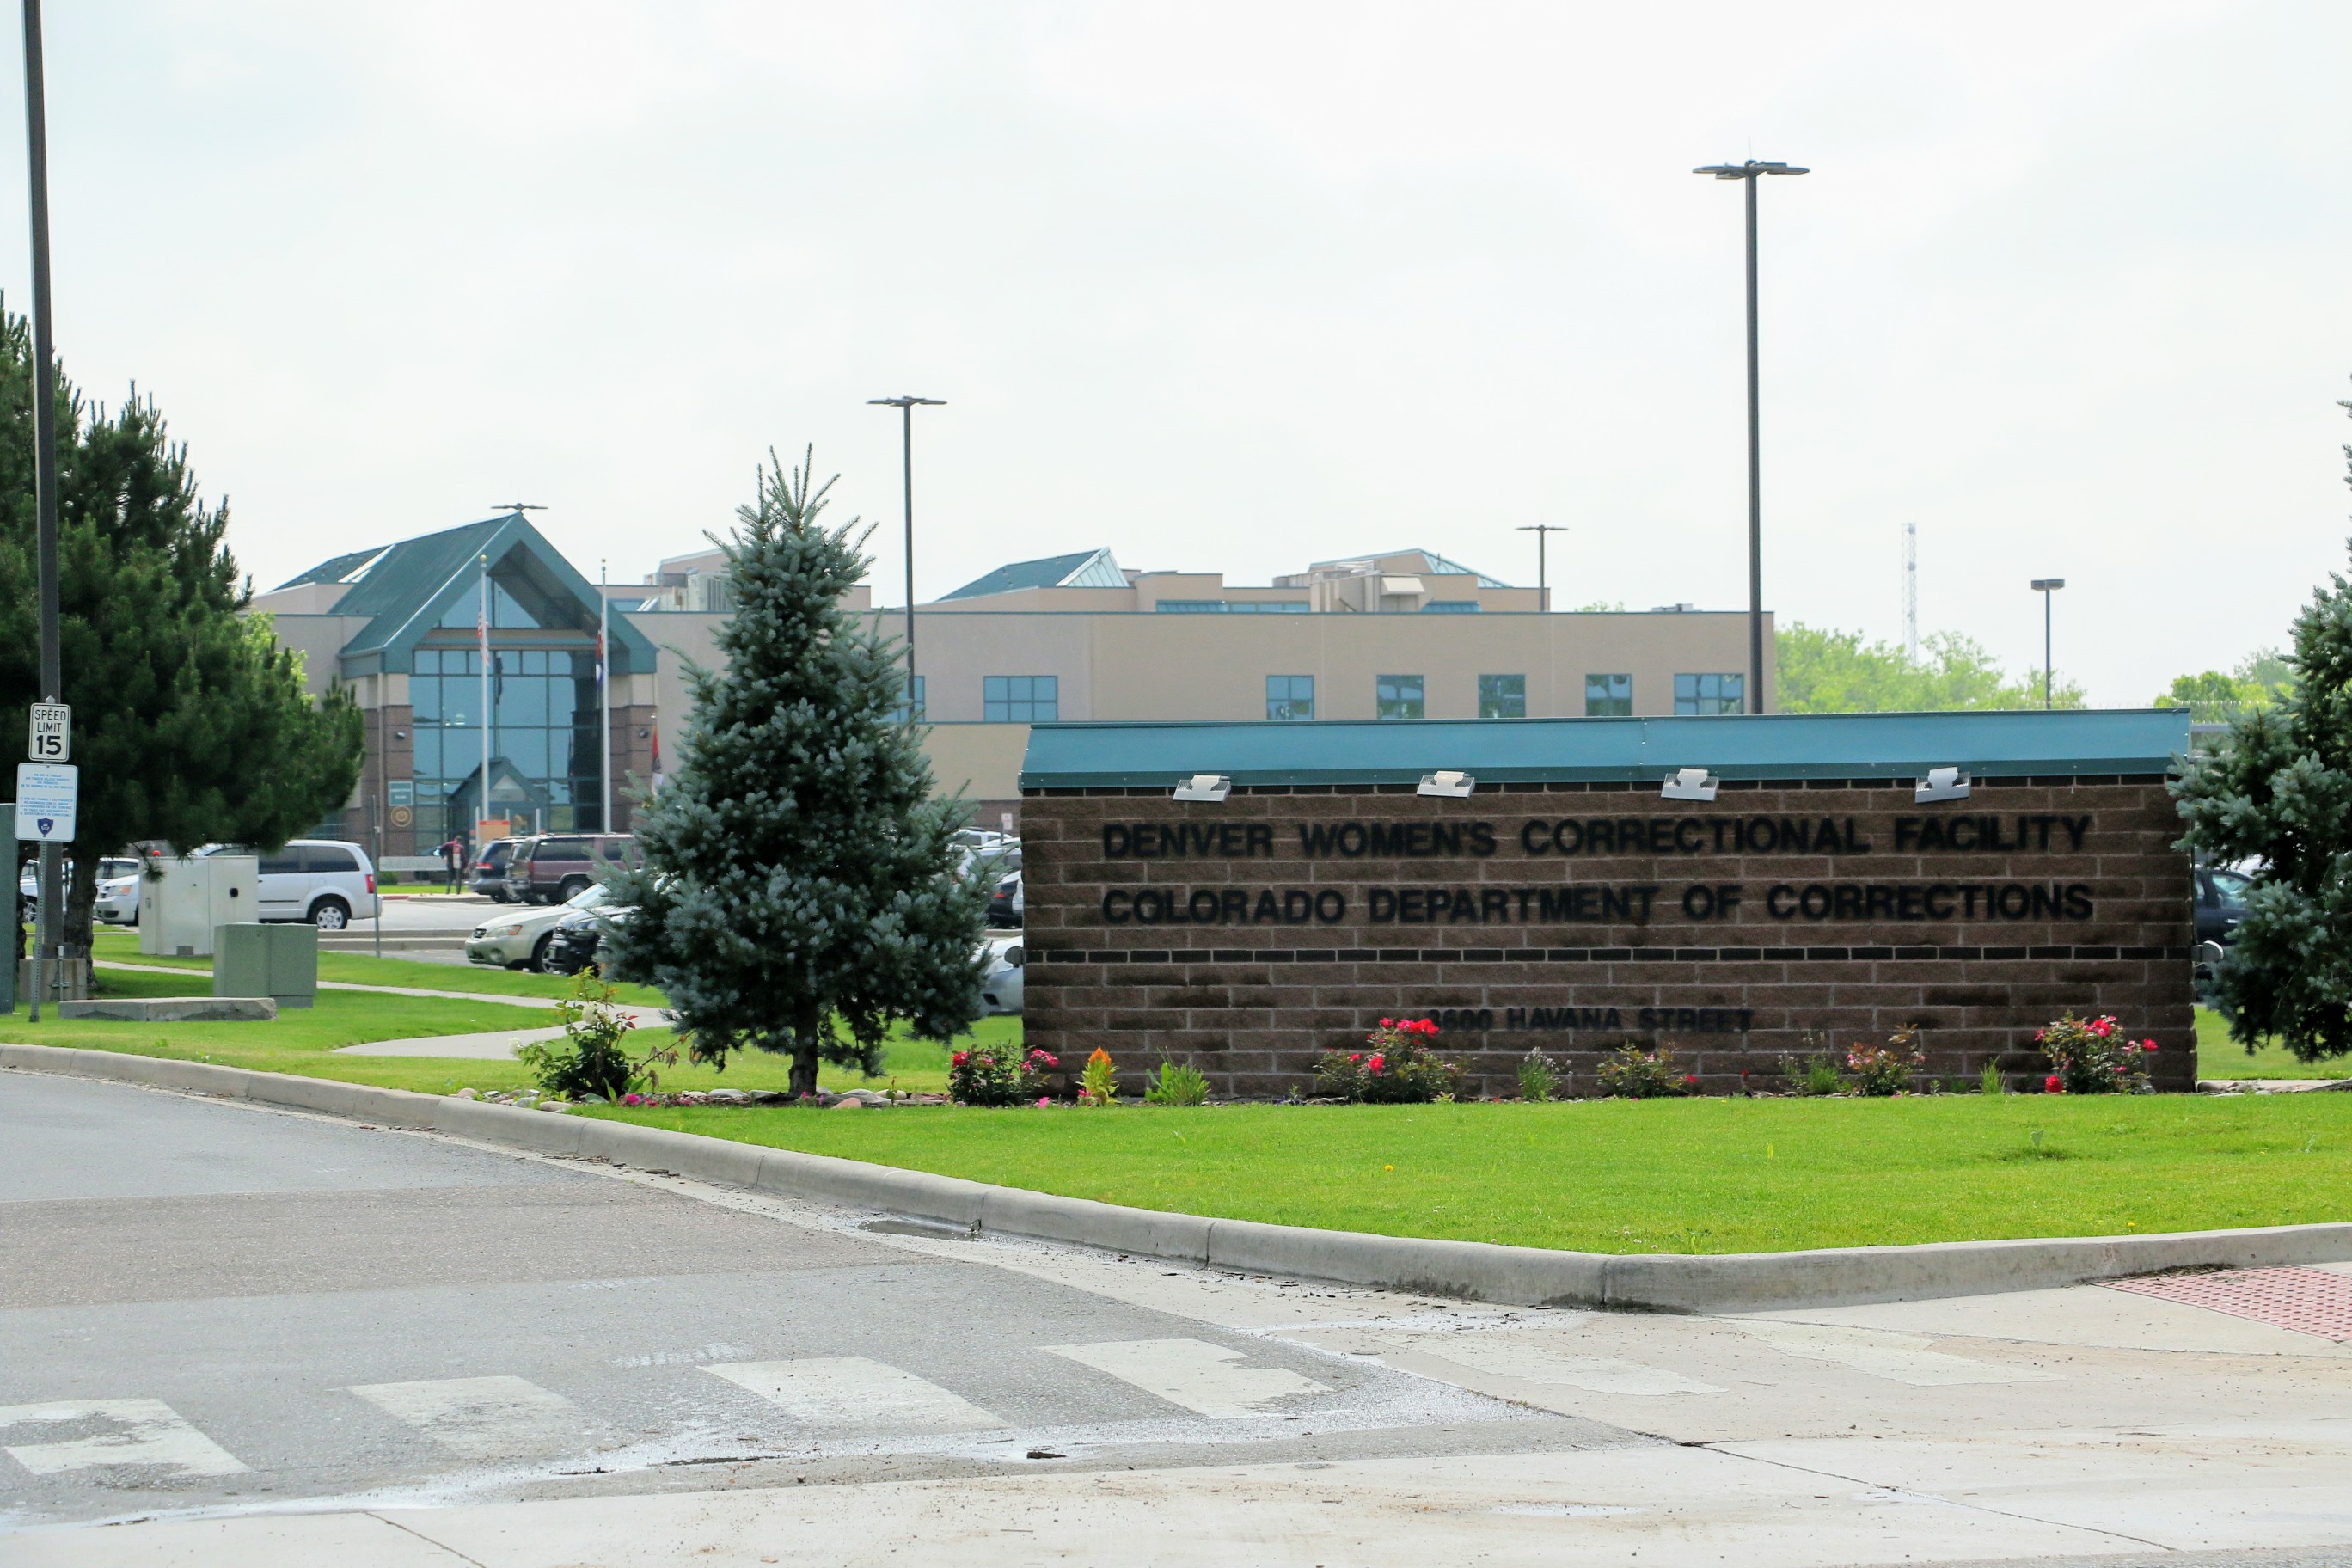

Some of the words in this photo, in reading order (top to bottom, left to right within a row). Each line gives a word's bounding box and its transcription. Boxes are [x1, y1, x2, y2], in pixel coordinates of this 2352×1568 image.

[34, 709, 66, 721] SPEED
[37, 723, 62, 732] LIMIT
[36, 735, 61, 755] 15
[1103, 824, 1272, 858] DENVER
[1298, 822, 1497, 857] WOMEN'S
[1521, 817, 1871, 854] CORRECTIONAL
[1896, 815, 2092, 852] FACILITY
[1102, 890, 1345, 924] COLORADO
[1369, 886, 1658, 923] DEPARTMENT
[1682, 885, 1743, 919] OF
[1767, 884, 2093, 920] CORRECTIONS
[1507, 1008, 1622, 1030] HAVANA
[1638, 1008, 1755, 1032] STREET
